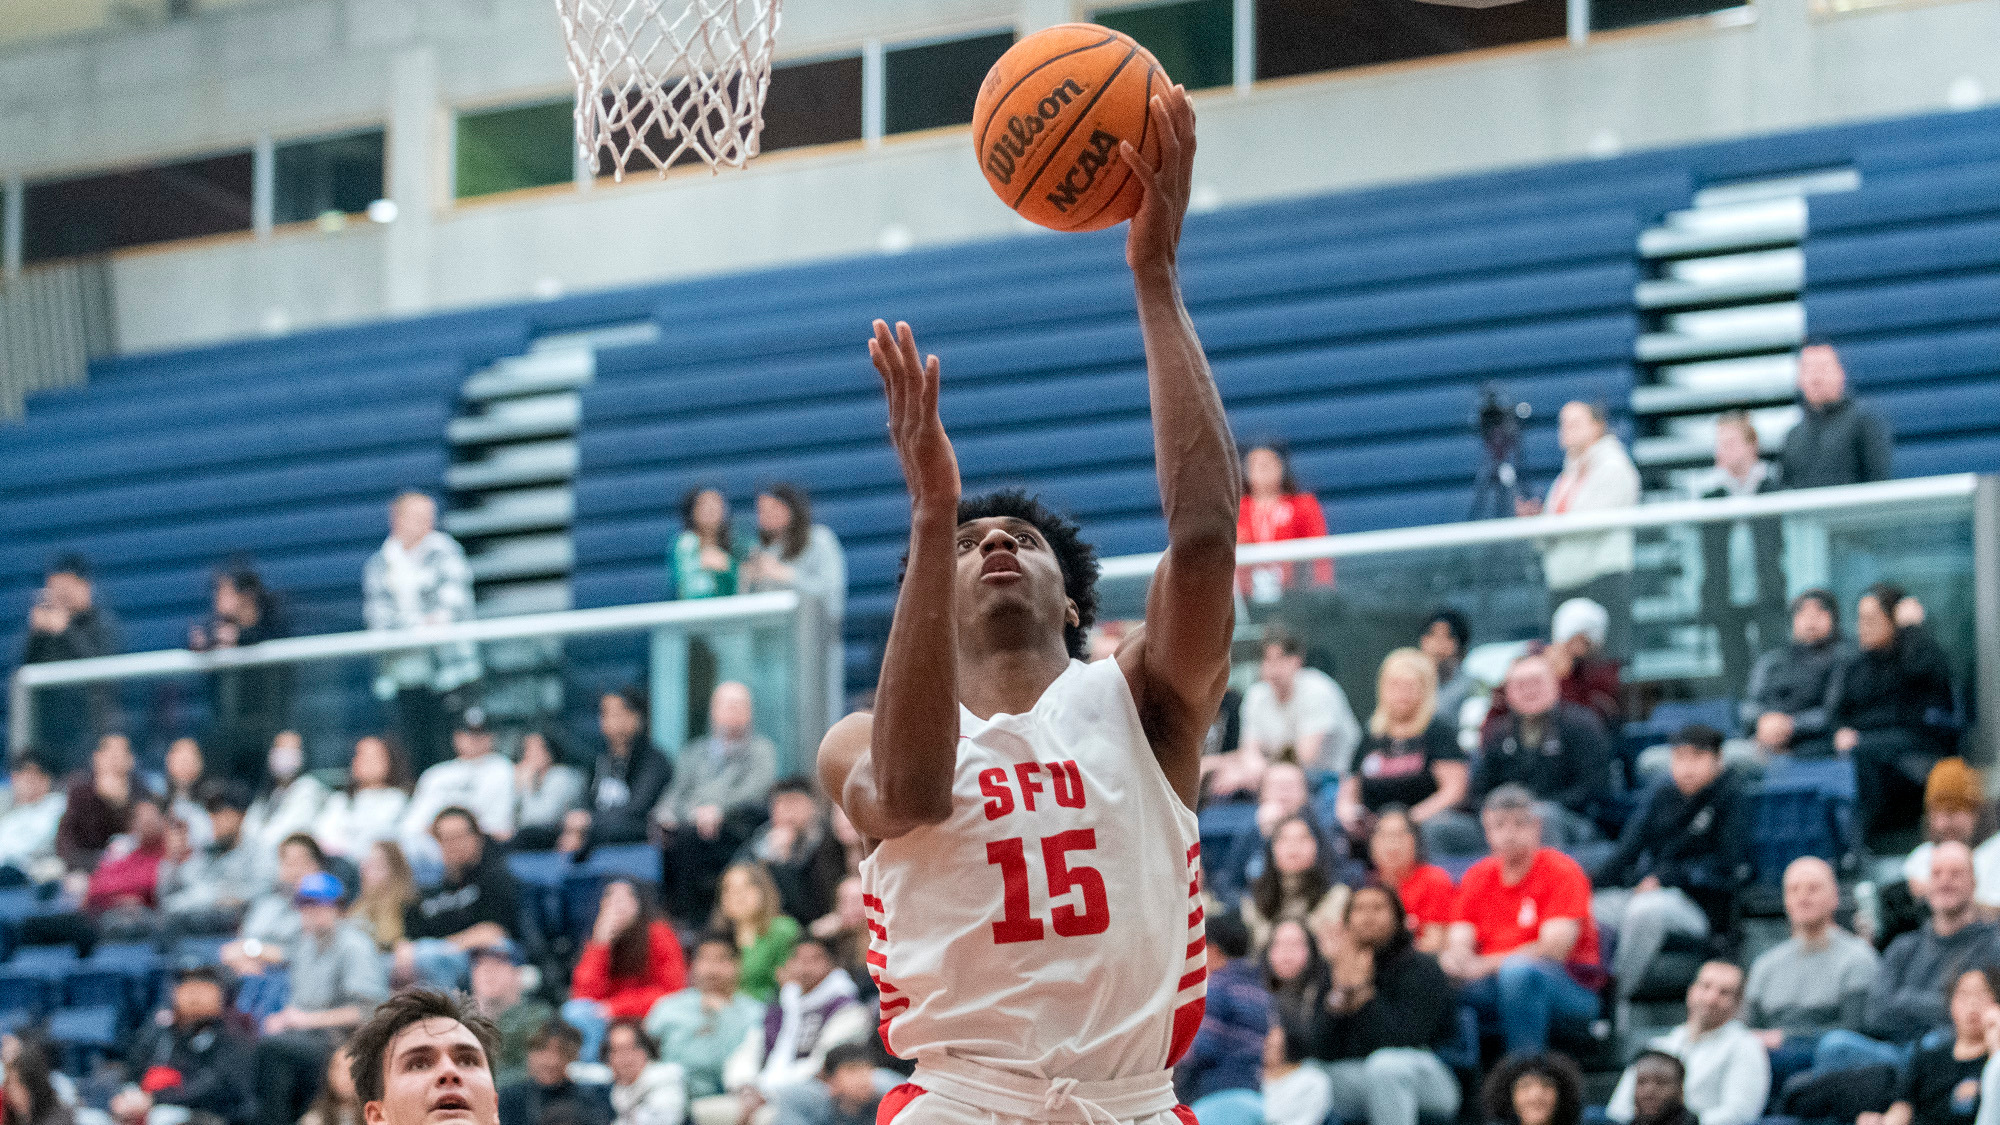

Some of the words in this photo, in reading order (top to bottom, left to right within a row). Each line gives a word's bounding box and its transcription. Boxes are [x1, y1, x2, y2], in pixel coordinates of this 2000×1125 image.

[986, 78, 1085, 185] Wilson
[1046, 129, 1119, 213] NCAA
[978, 759, 1086, 821] SFU
[985, 828, 1110, 945] 15
